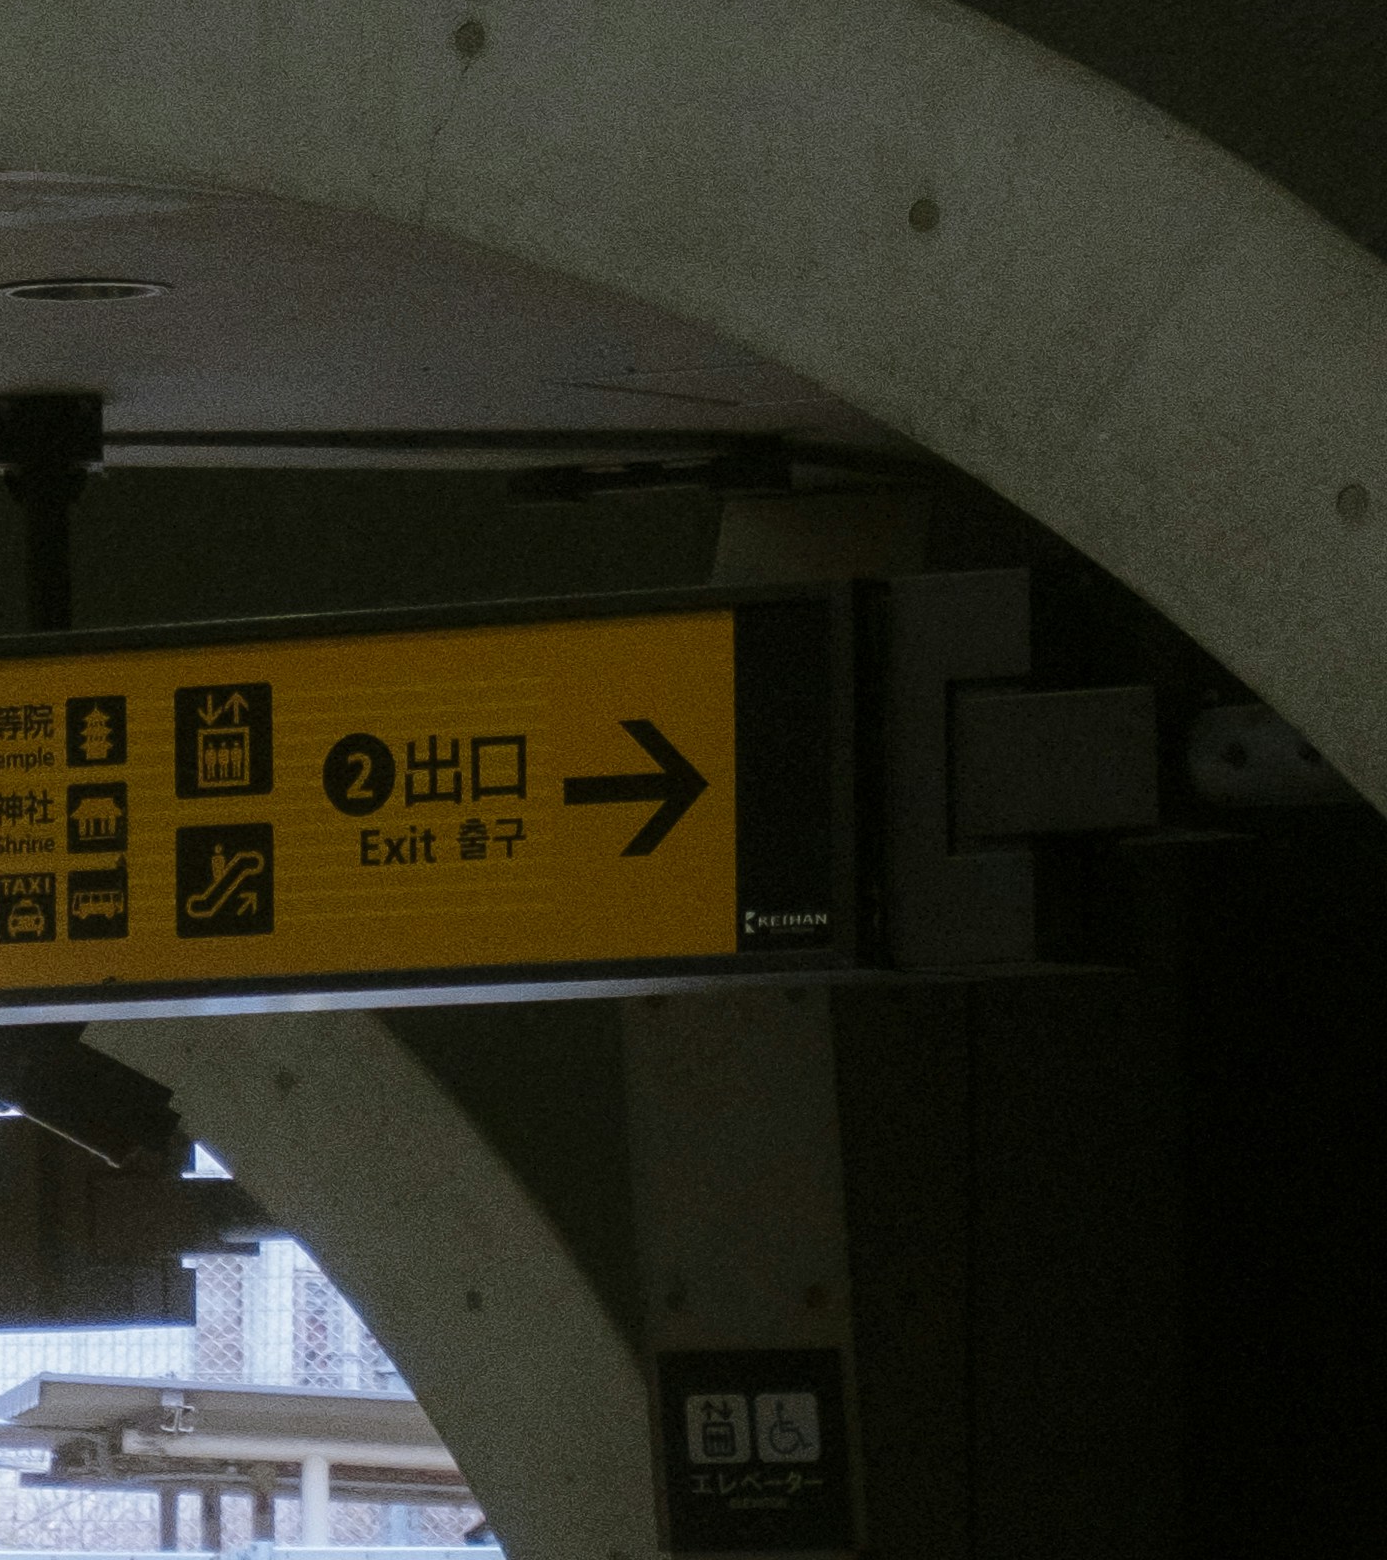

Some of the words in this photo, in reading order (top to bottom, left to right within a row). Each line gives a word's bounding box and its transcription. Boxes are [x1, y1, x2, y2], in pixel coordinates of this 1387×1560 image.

[360, 825, 436, 866] Exit
[457, 818, 527, 861] 출구
[1, 877, 52, 896] TAXI
